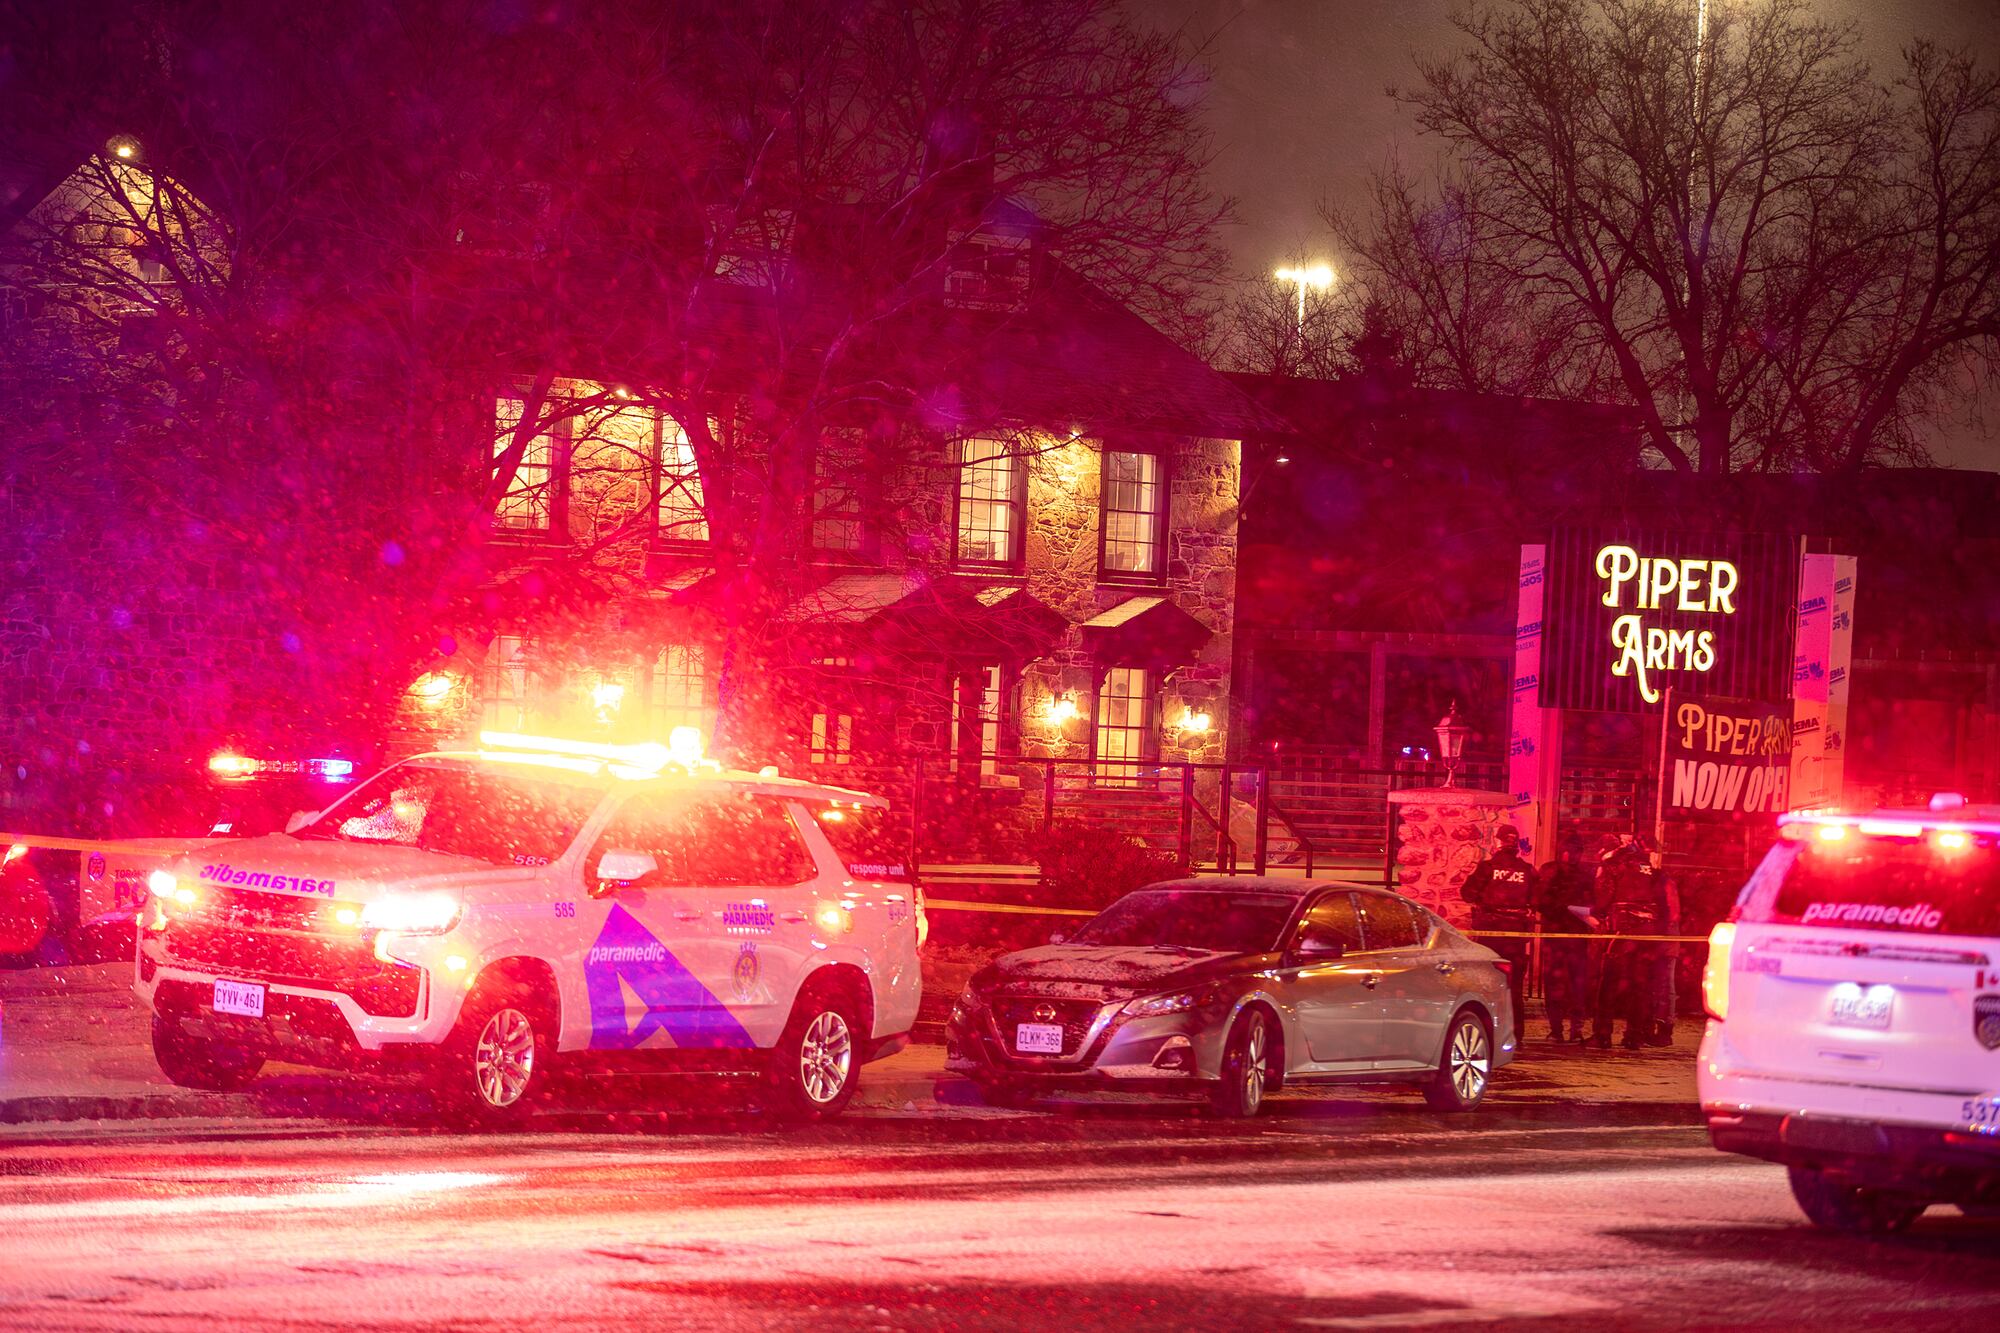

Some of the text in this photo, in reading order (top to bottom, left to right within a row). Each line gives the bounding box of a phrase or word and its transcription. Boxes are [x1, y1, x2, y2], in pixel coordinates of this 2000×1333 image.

[1596, 545, 1737, 613] PIPER
[1612, 615, 1714, 703] ARMS
[1677, 703, 1761, 756] PIPER
[1672, 759, 1748, 811] NOW
[514, 854, 549, 866] 585
[850, 863, 905, 876] response unit
[1493, 869, 1525, 883] POCE
[554, 902, 575, 918] 585
[723, 912, 775, 926] PARAMEDIC
[1801, 903, 1942, 928] paramedic
[590, 942, 665, 966] paramedic
[243, 992, 260, 1009] 461
[1962, 1101, 2000, 1123] 537
